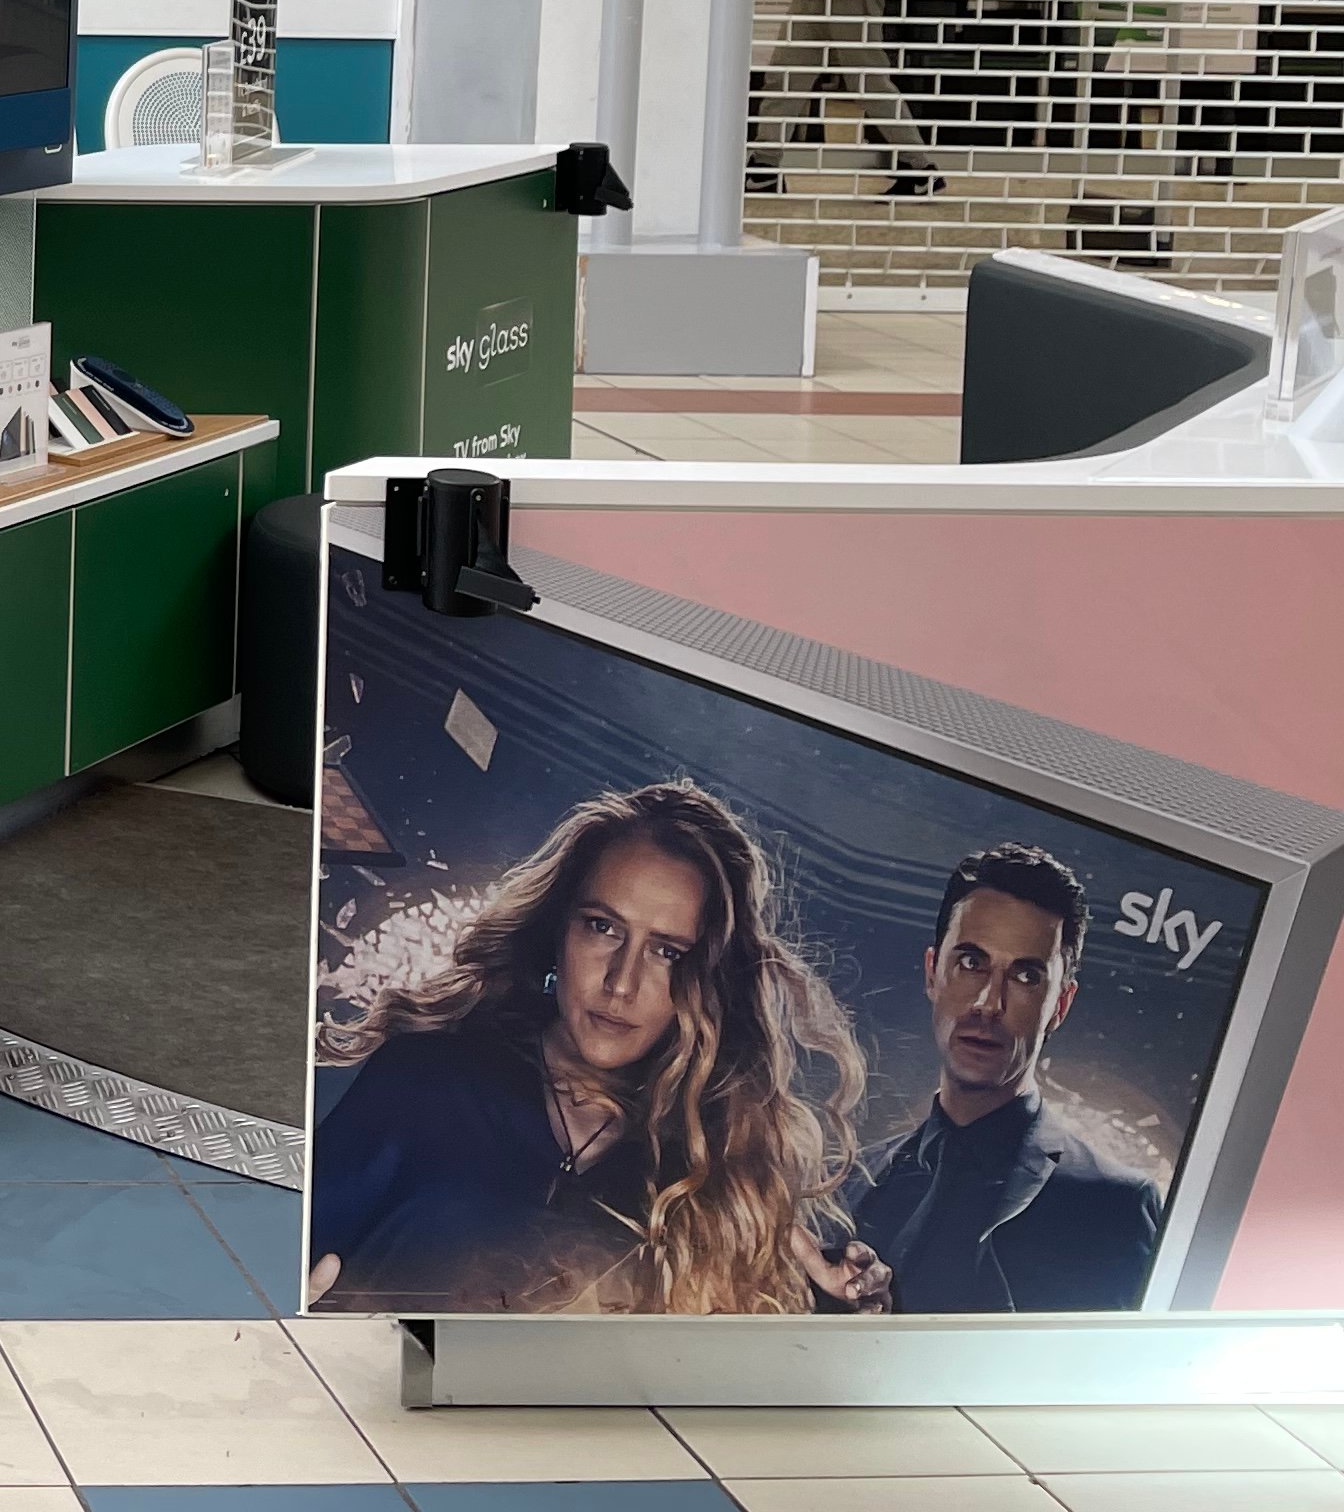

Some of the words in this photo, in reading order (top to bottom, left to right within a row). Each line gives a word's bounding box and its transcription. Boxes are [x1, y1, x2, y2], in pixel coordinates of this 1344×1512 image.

[446, 336, 475, 373] sky
[478, 323, 528, 370] glass
[471, 433, 497, 457] from
[500, 424, 521, 448] Sky
[1114, 887, 1223, 970] sky
